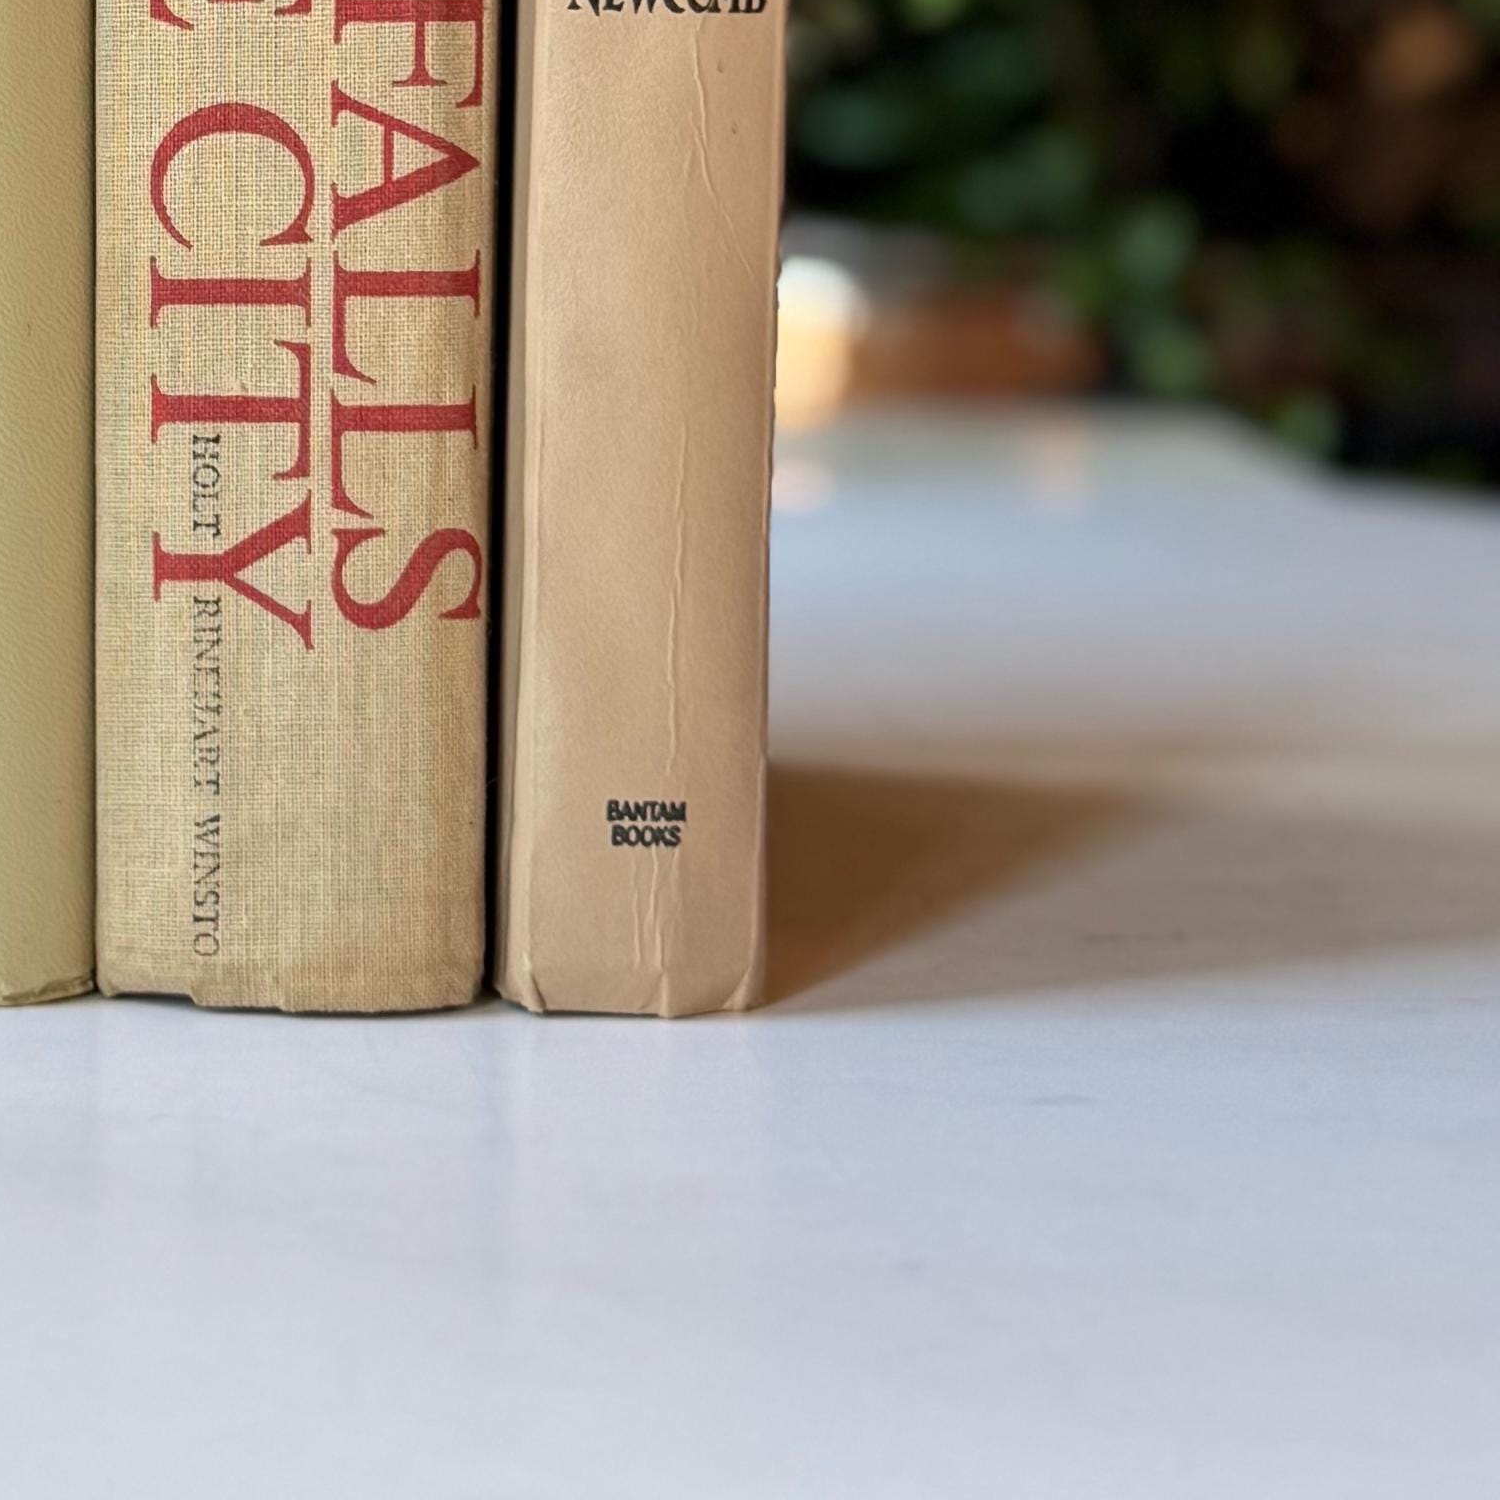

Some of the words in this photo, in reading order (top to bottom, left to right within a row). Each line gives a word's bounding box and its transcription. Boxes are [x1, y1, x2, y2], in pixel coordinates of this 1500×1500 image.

[149, 101, 314, 650] CITY
[192, 433, 221, 539] HOLT
[607, 800, 687, 822] BANTAM
[612, 825, 681, 848] BOOKS
